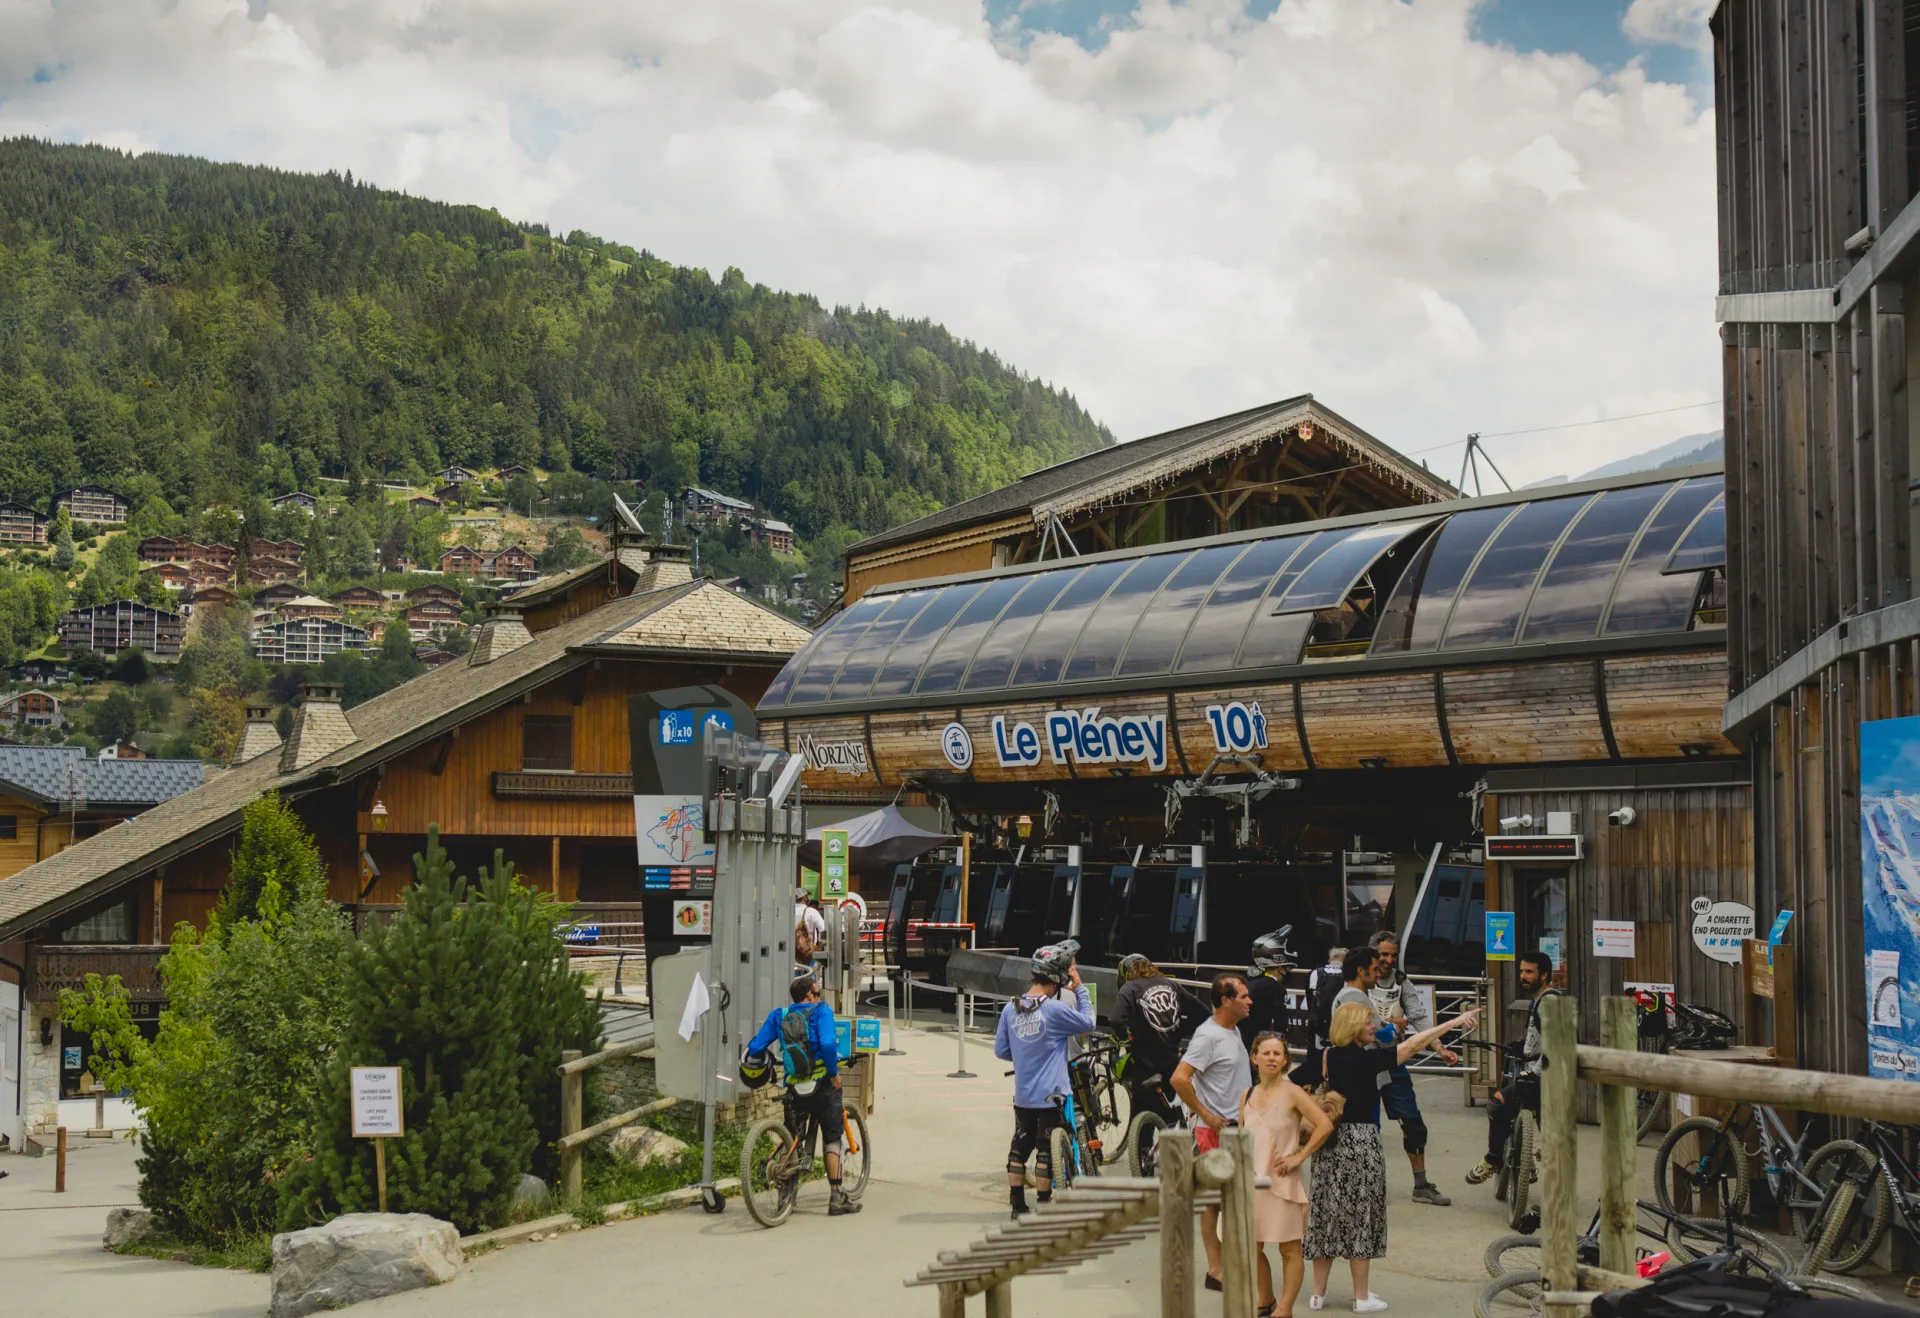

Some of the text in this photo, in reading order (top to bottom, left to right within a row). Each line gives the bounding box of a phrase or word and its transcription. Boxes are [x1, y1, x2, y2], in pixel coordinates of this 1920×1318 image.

[677, 727, 692, 737] x10
[1209, 706, 1250, 748] 10
[996, 713, 1163, 765] Le Pléney
[798, 740, 866, 768] MORZINE
[1694, 901, 1709, 911] OH!
[1713, 916, 1751, 924] CIGARETTE
[1694, 927, 1754, 936] END POLLUTES UP
[1720, 938, 1729, 947] OF
[1018, 1022, 1041, 1039] CRUZ
[1873, 1049, 1918, 1071] Portes du Soleil
